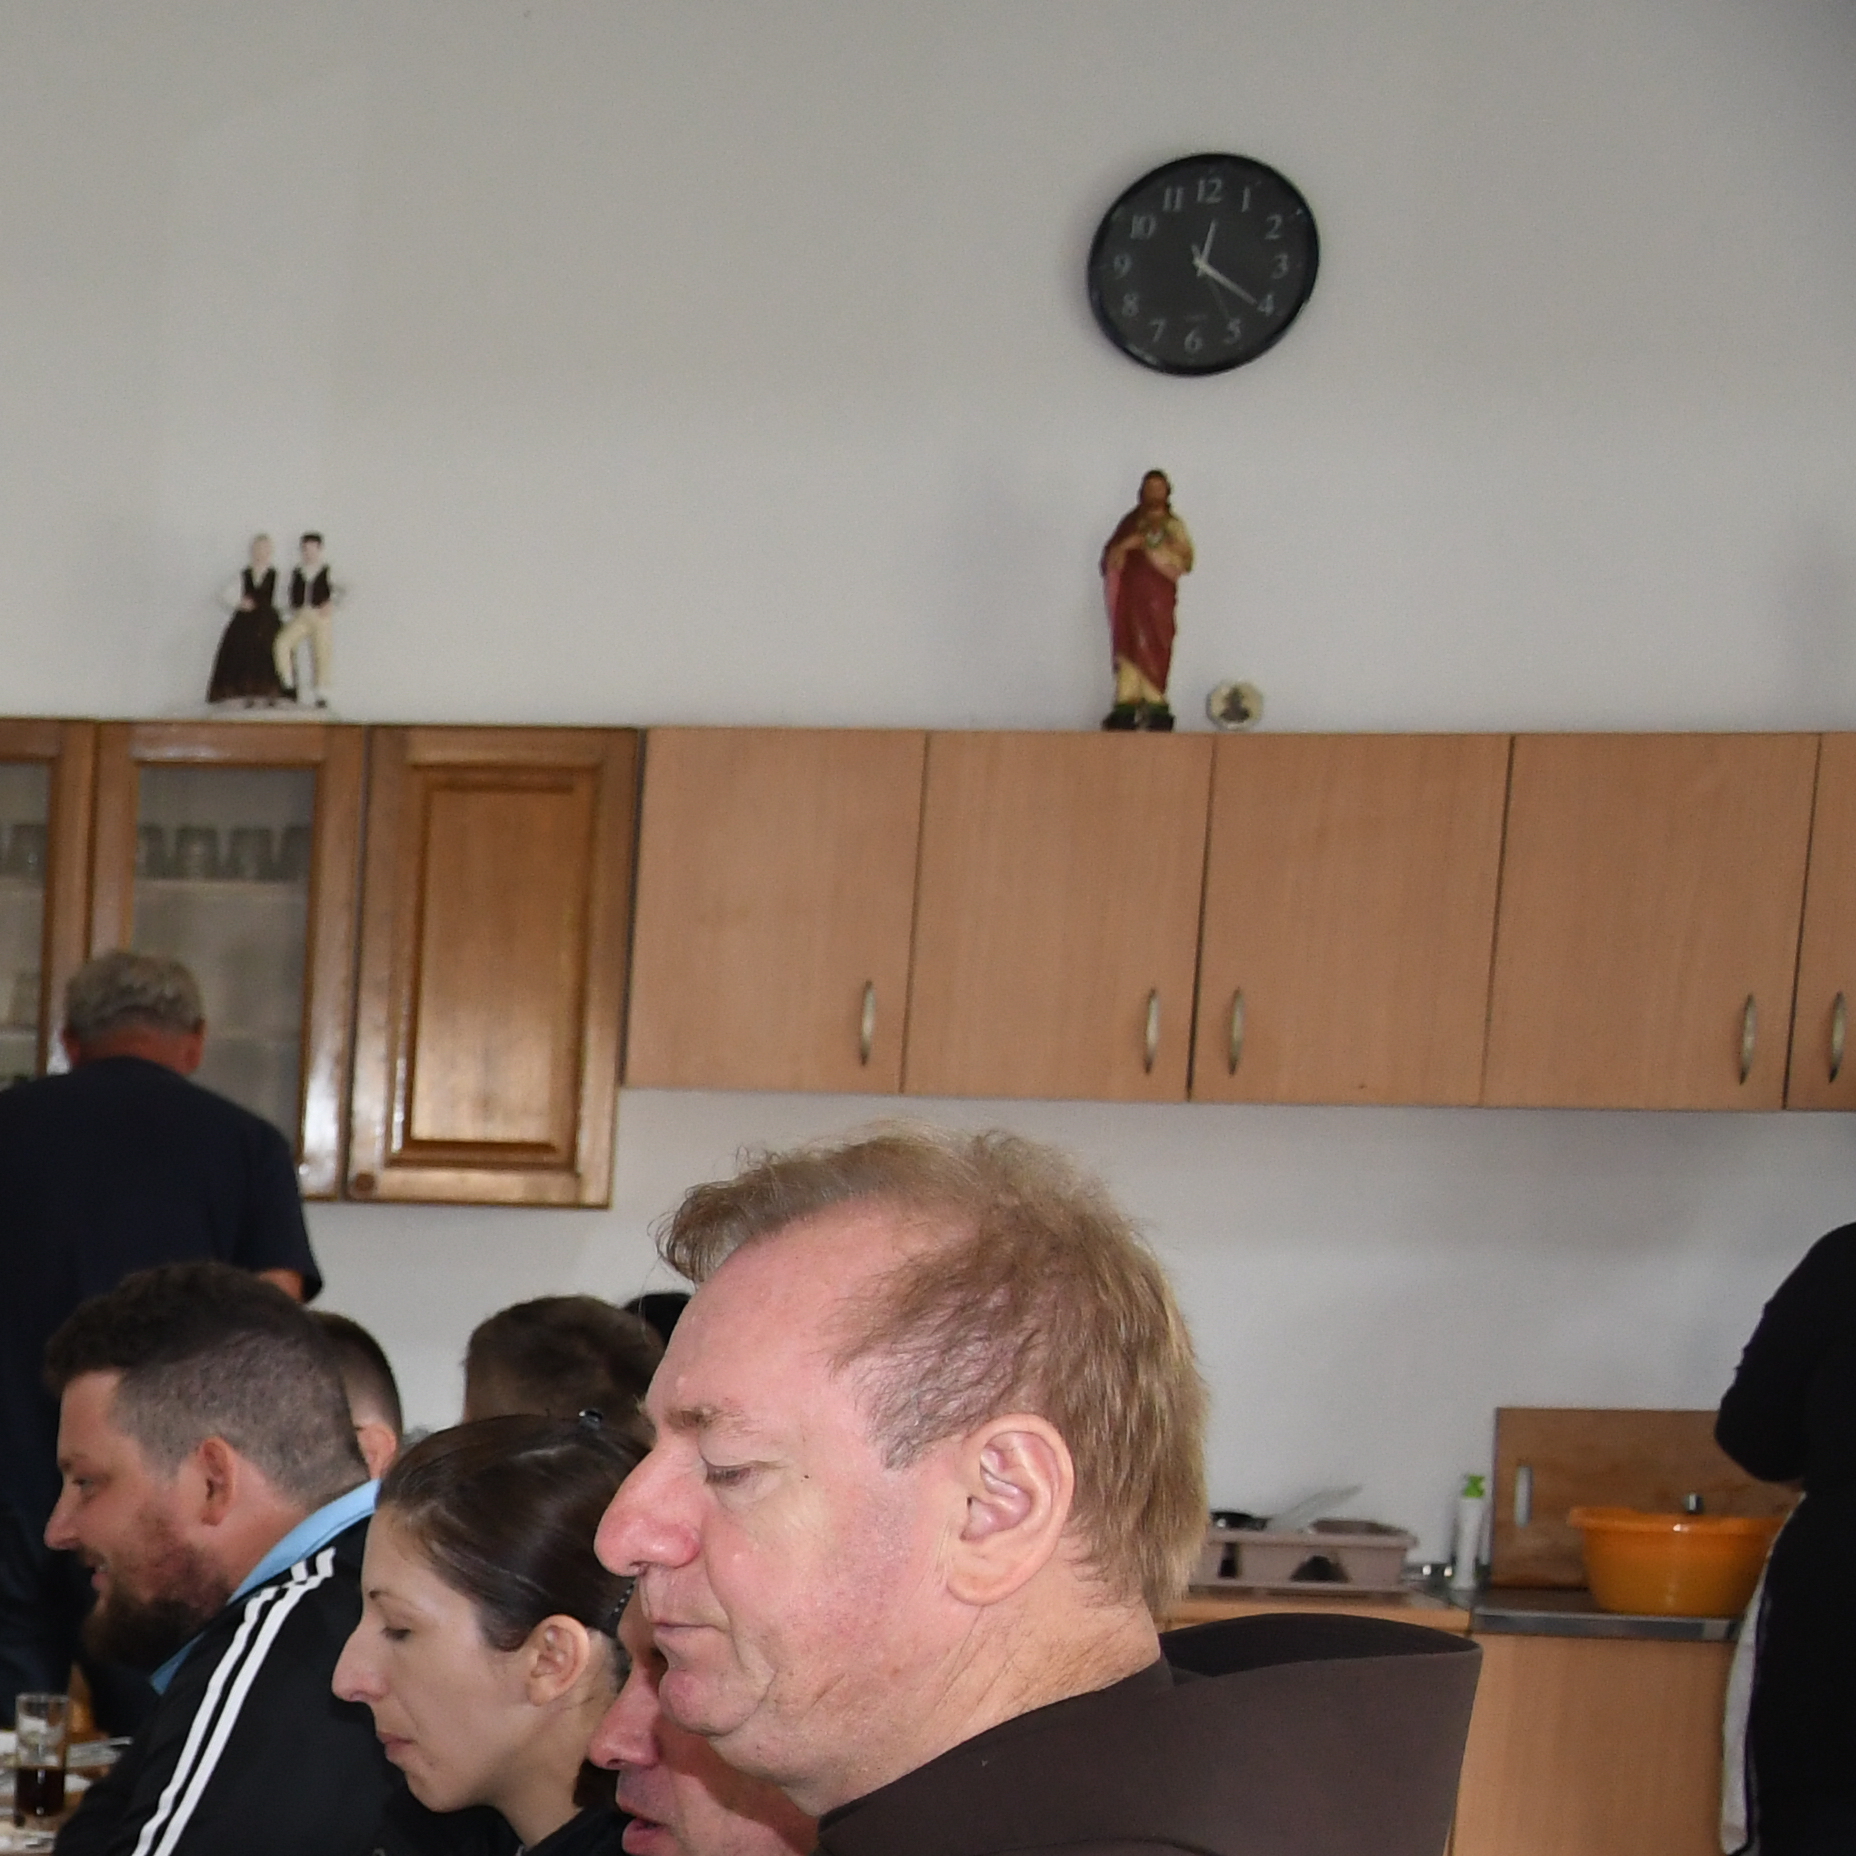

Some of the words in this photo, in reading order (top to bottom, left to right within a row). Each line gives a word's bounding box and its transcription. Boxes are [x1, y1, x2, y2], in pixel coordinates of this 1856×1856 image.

[1162, 186, 1185, 212] 11
[1196, 178, 1222, 204] 12
[1241, 186, 1251, 212] 1
[1130, 213, 1158, 240] 10
[1265, 213, 1283, 240] 2
[1113, 253, 1132, 280] 9
[1272, 254, 1289, 279] 3
[1122, 293, 1139, 317] 8
[1257, 293, 1275, 316] 4
[1150, 318, 1166, 342] 7
[1184, 329, 1203, 351] 6
[1224, 318, 1242, 344] 5
